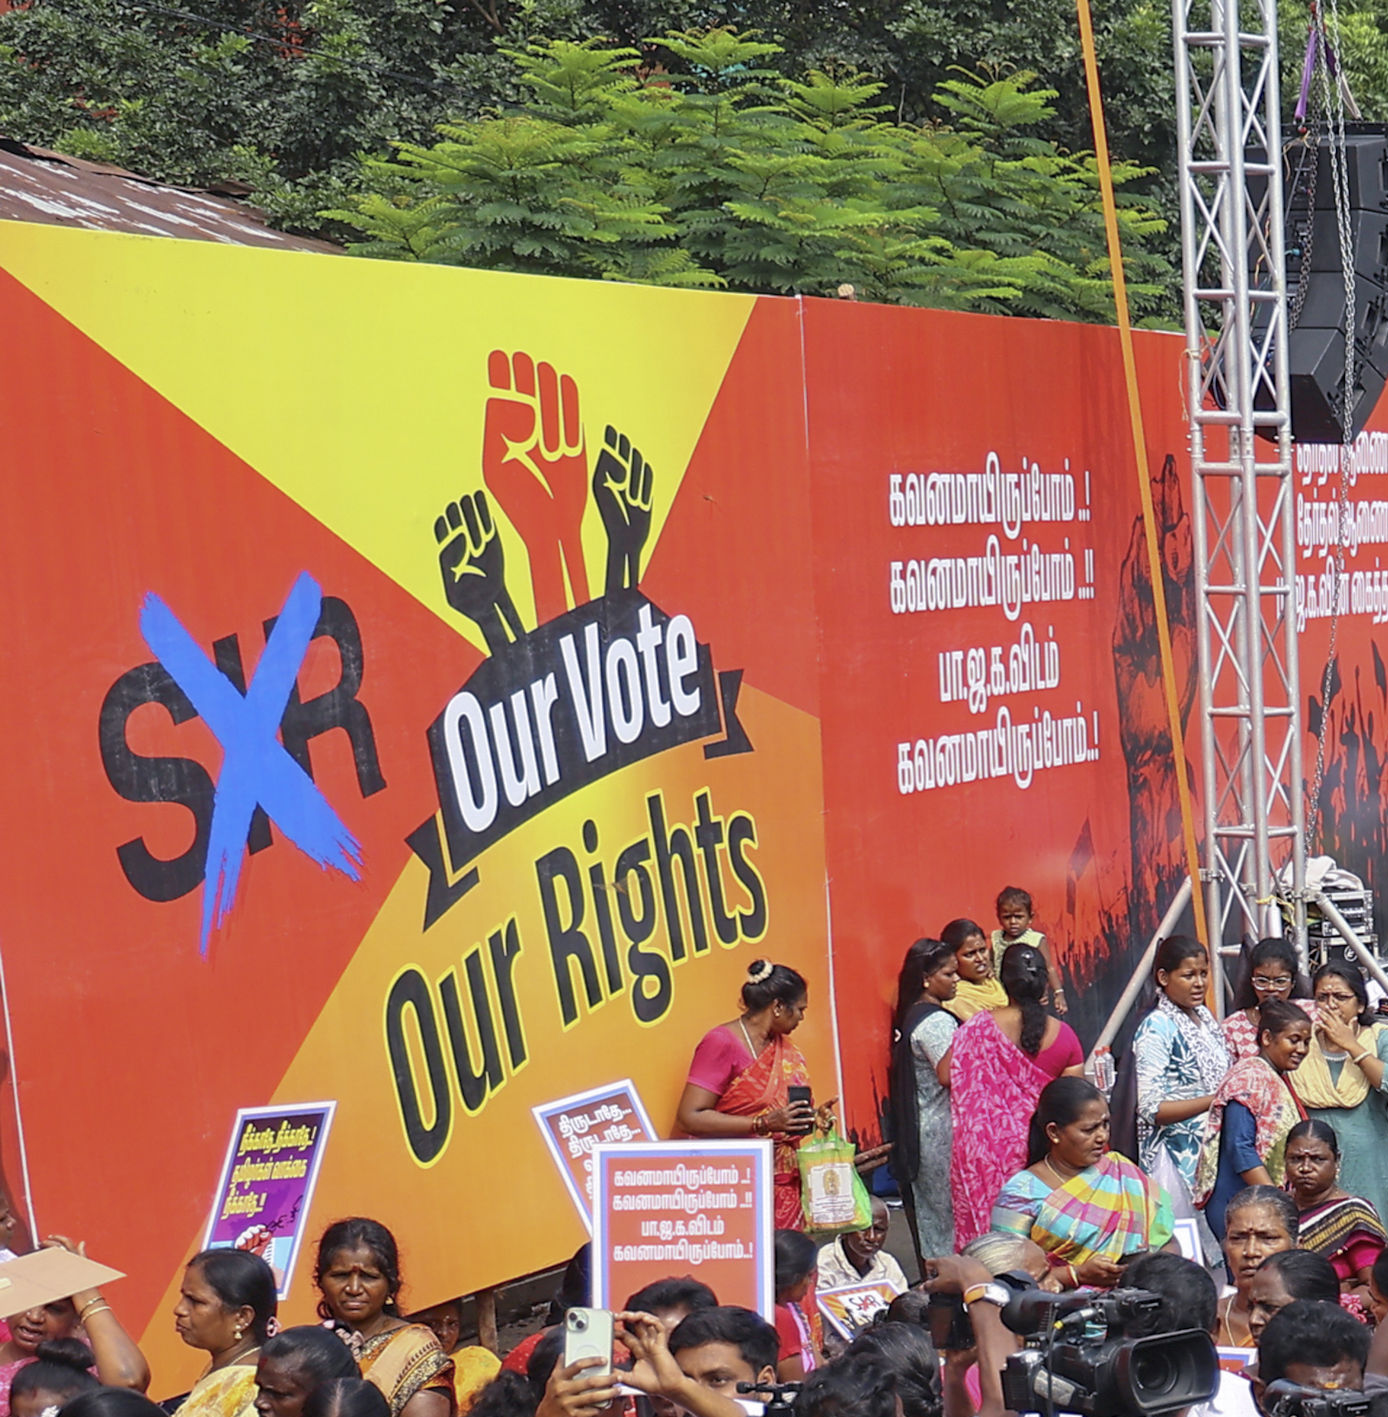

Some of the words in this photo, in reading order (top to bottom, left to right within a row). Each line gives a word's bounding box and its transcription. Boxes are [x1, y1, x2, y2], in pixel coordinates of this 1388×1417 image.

[442, 685, 558, 834] Our
[558, 611, 703, 758] Vote
[386, 918, 524, 1165] Our
[536, 790, 766, 1029] Rights
